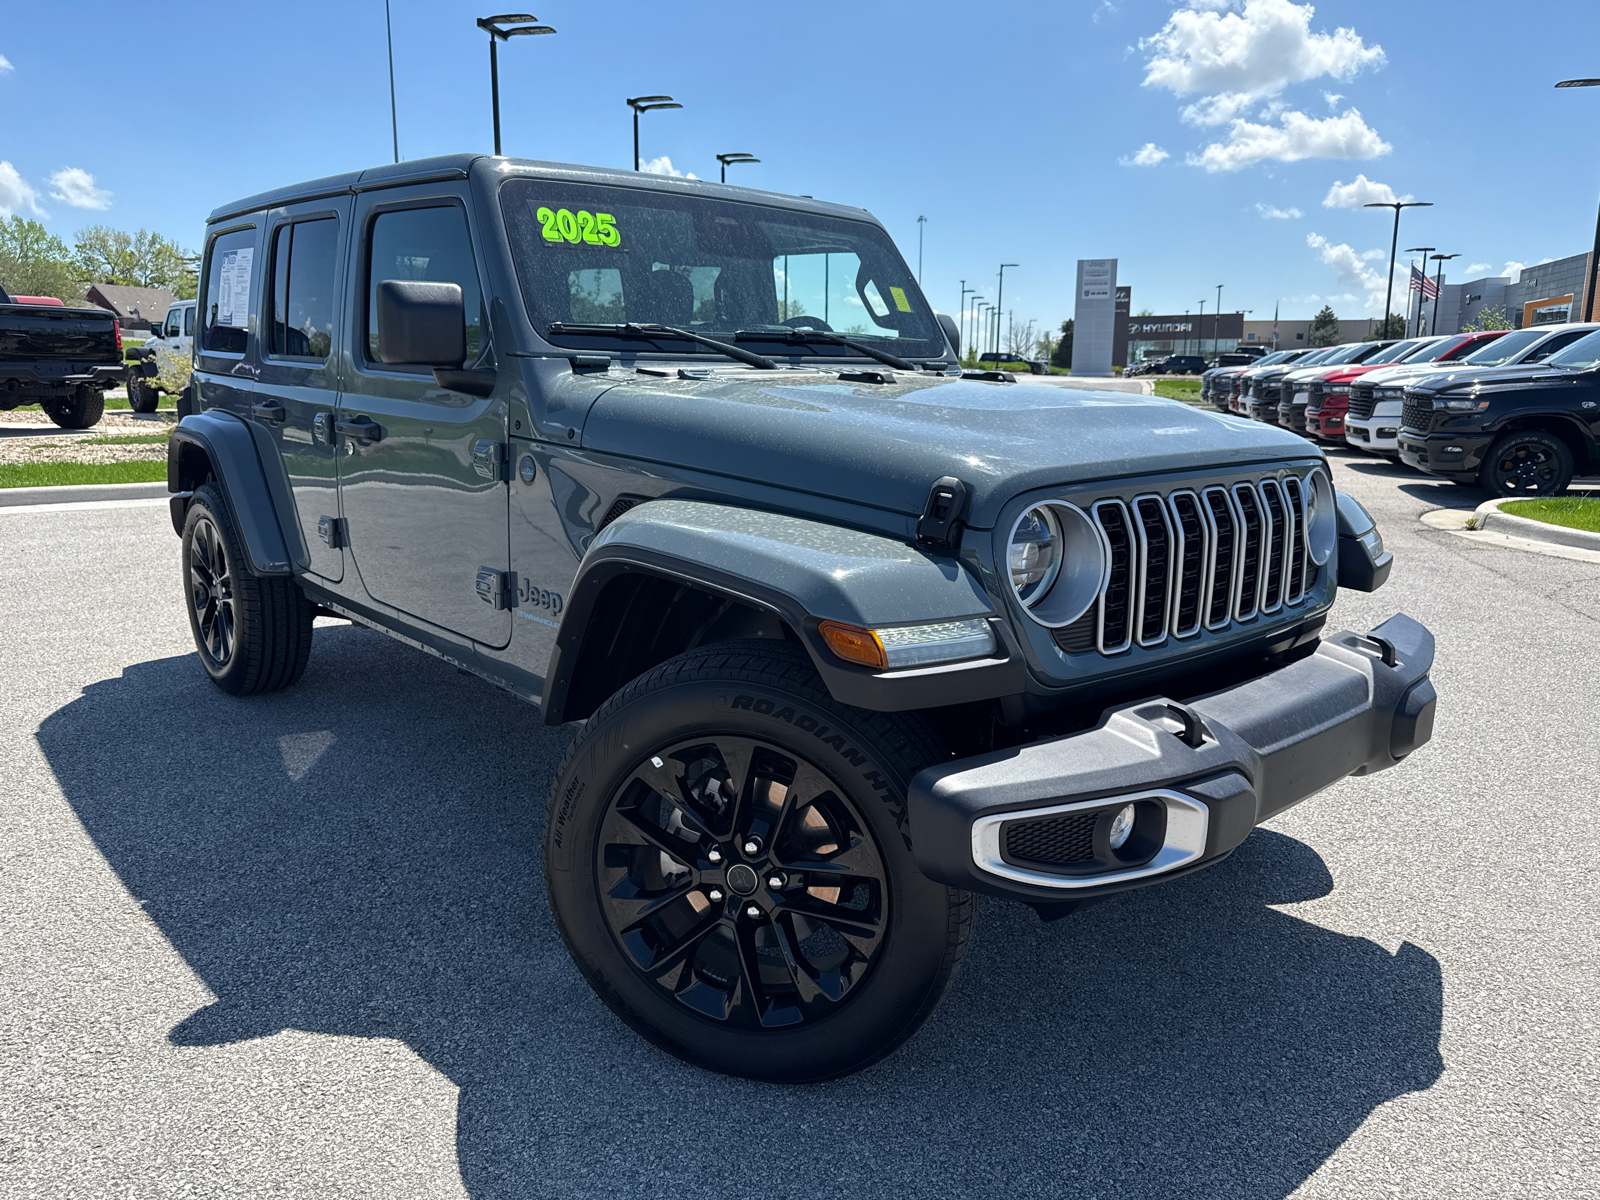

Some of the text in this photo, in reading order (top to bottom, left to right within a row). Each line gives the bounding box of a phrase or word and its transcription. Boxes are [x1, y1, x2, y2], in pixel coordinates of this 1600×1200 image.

[537, 207, 621, 247] 2025
[1142, 323, 1193, 333] HYUNDAI
[517, 578, 563, 617] Jeep
[731, 695, 867, 768] ROADIAN
[554, 775, 580, 849] All-Weather
[567, 782, 586, 822] Performance
